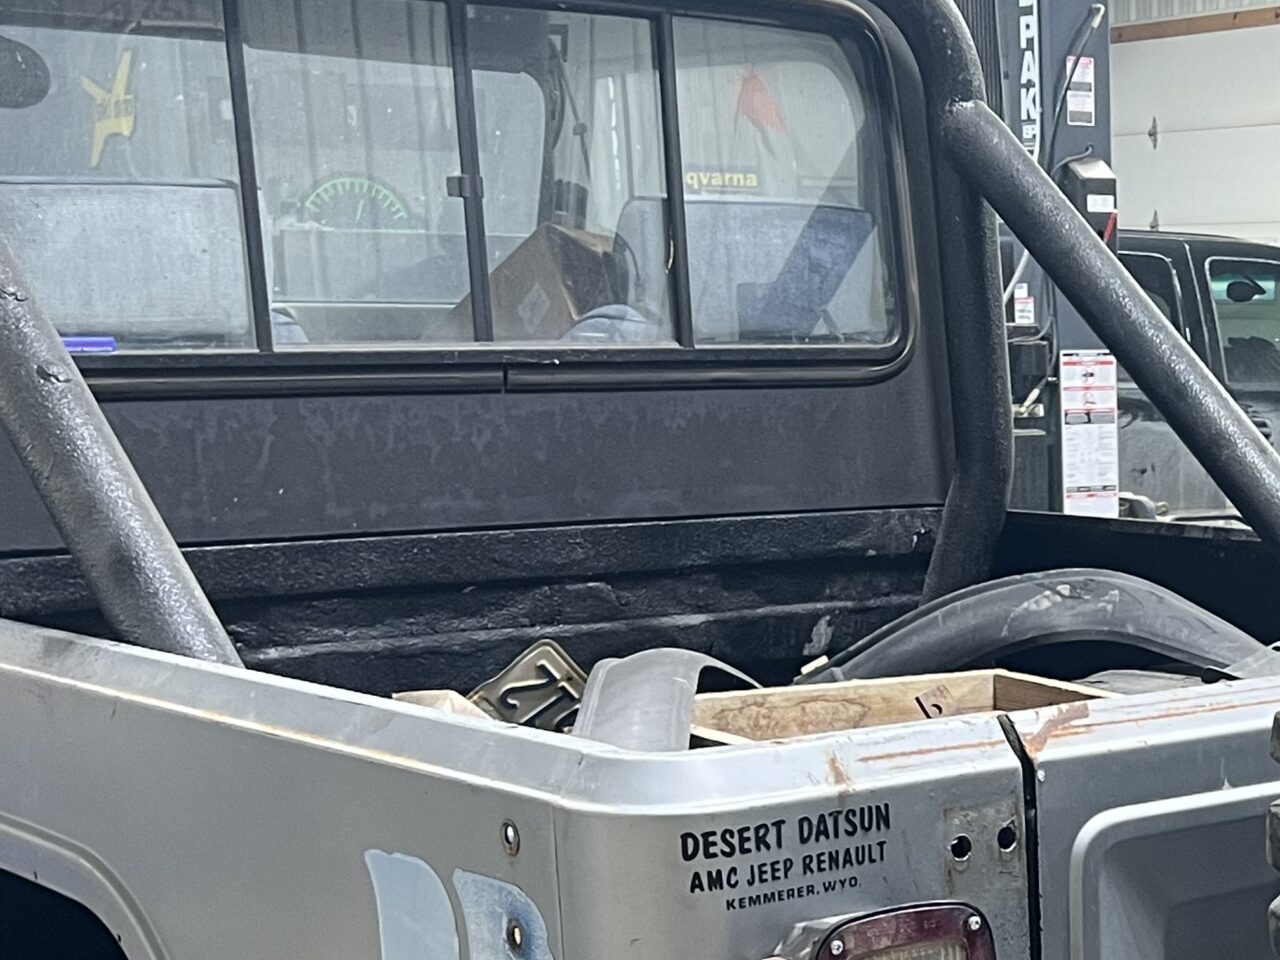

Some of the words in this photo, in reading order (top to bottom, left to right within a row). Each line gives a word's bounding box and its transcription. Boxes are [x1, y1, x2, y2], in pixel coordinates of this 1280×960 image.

[1019, 0, 1037, 120] PAK
[686, 172, 757, 189] qvarna
[680, 819, 786, 862] DESERT
[798, 803, 891, 844] DATSUN
[690, 866, 739, 894] AMC
[747, 857, 794, 887] JEEP
[802, 840, 887, 876] RENAULT
[726, 885, 820, 911] KEMMERER,
